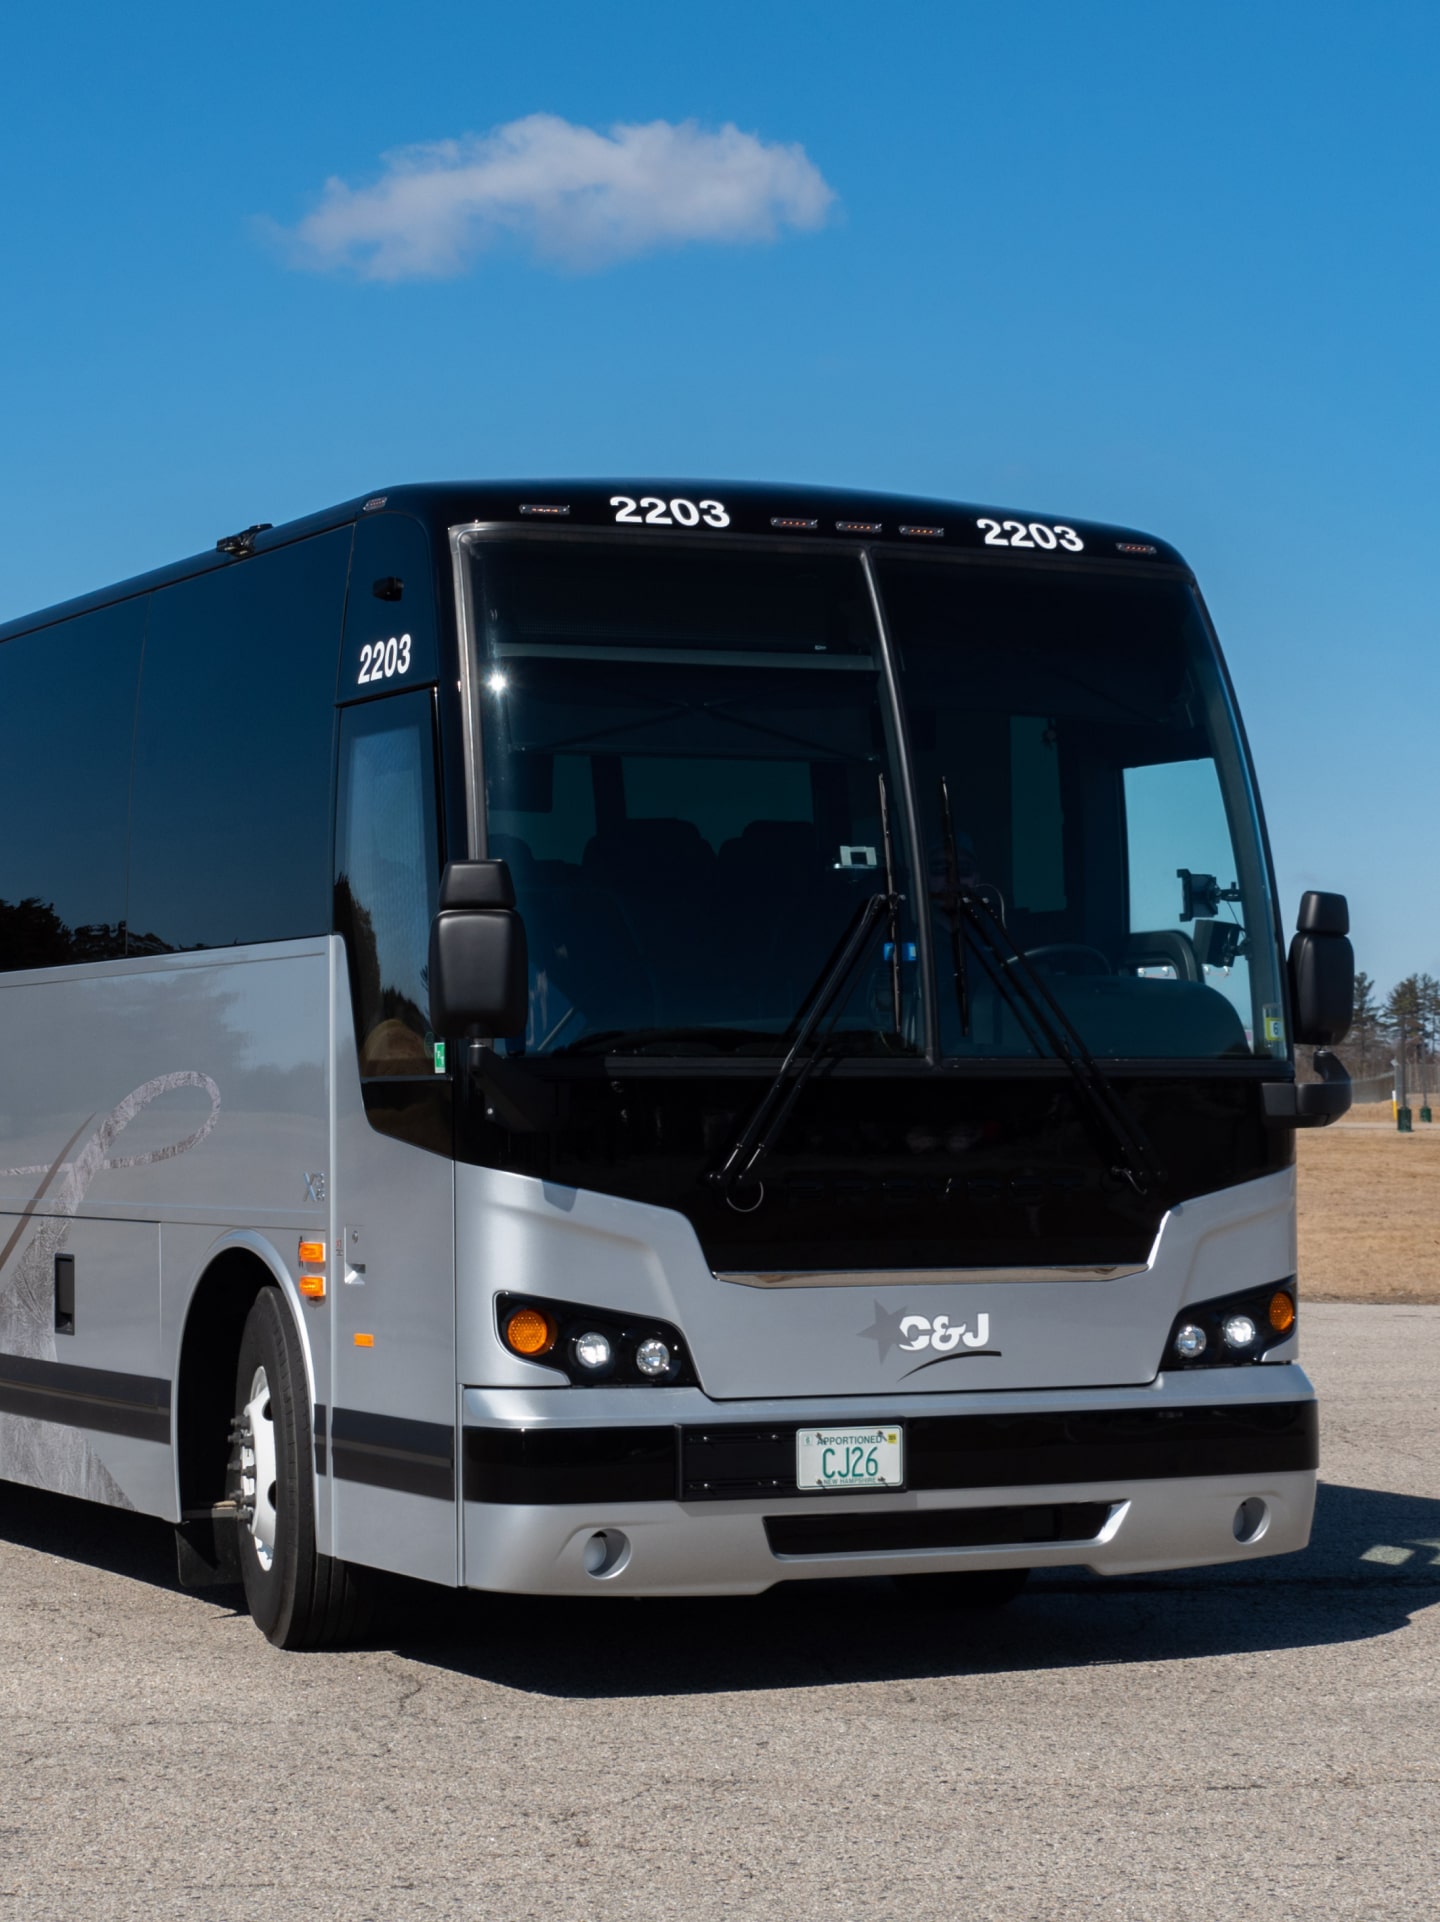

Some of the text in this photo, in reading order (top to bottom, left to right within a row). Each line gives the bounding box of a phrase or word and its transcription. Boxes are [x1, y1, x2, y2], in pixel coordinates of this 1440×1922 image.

[610, 497, 730, 528] 2203
[976, 518, 1084, 552] 2203
[357, 634, 412, 684] 2203
[899, 1313, 990, 1351] C&J
[817, 1435, 883, 1445] APPORTIONED
[822, 1446, 878, 1478] CJ26
